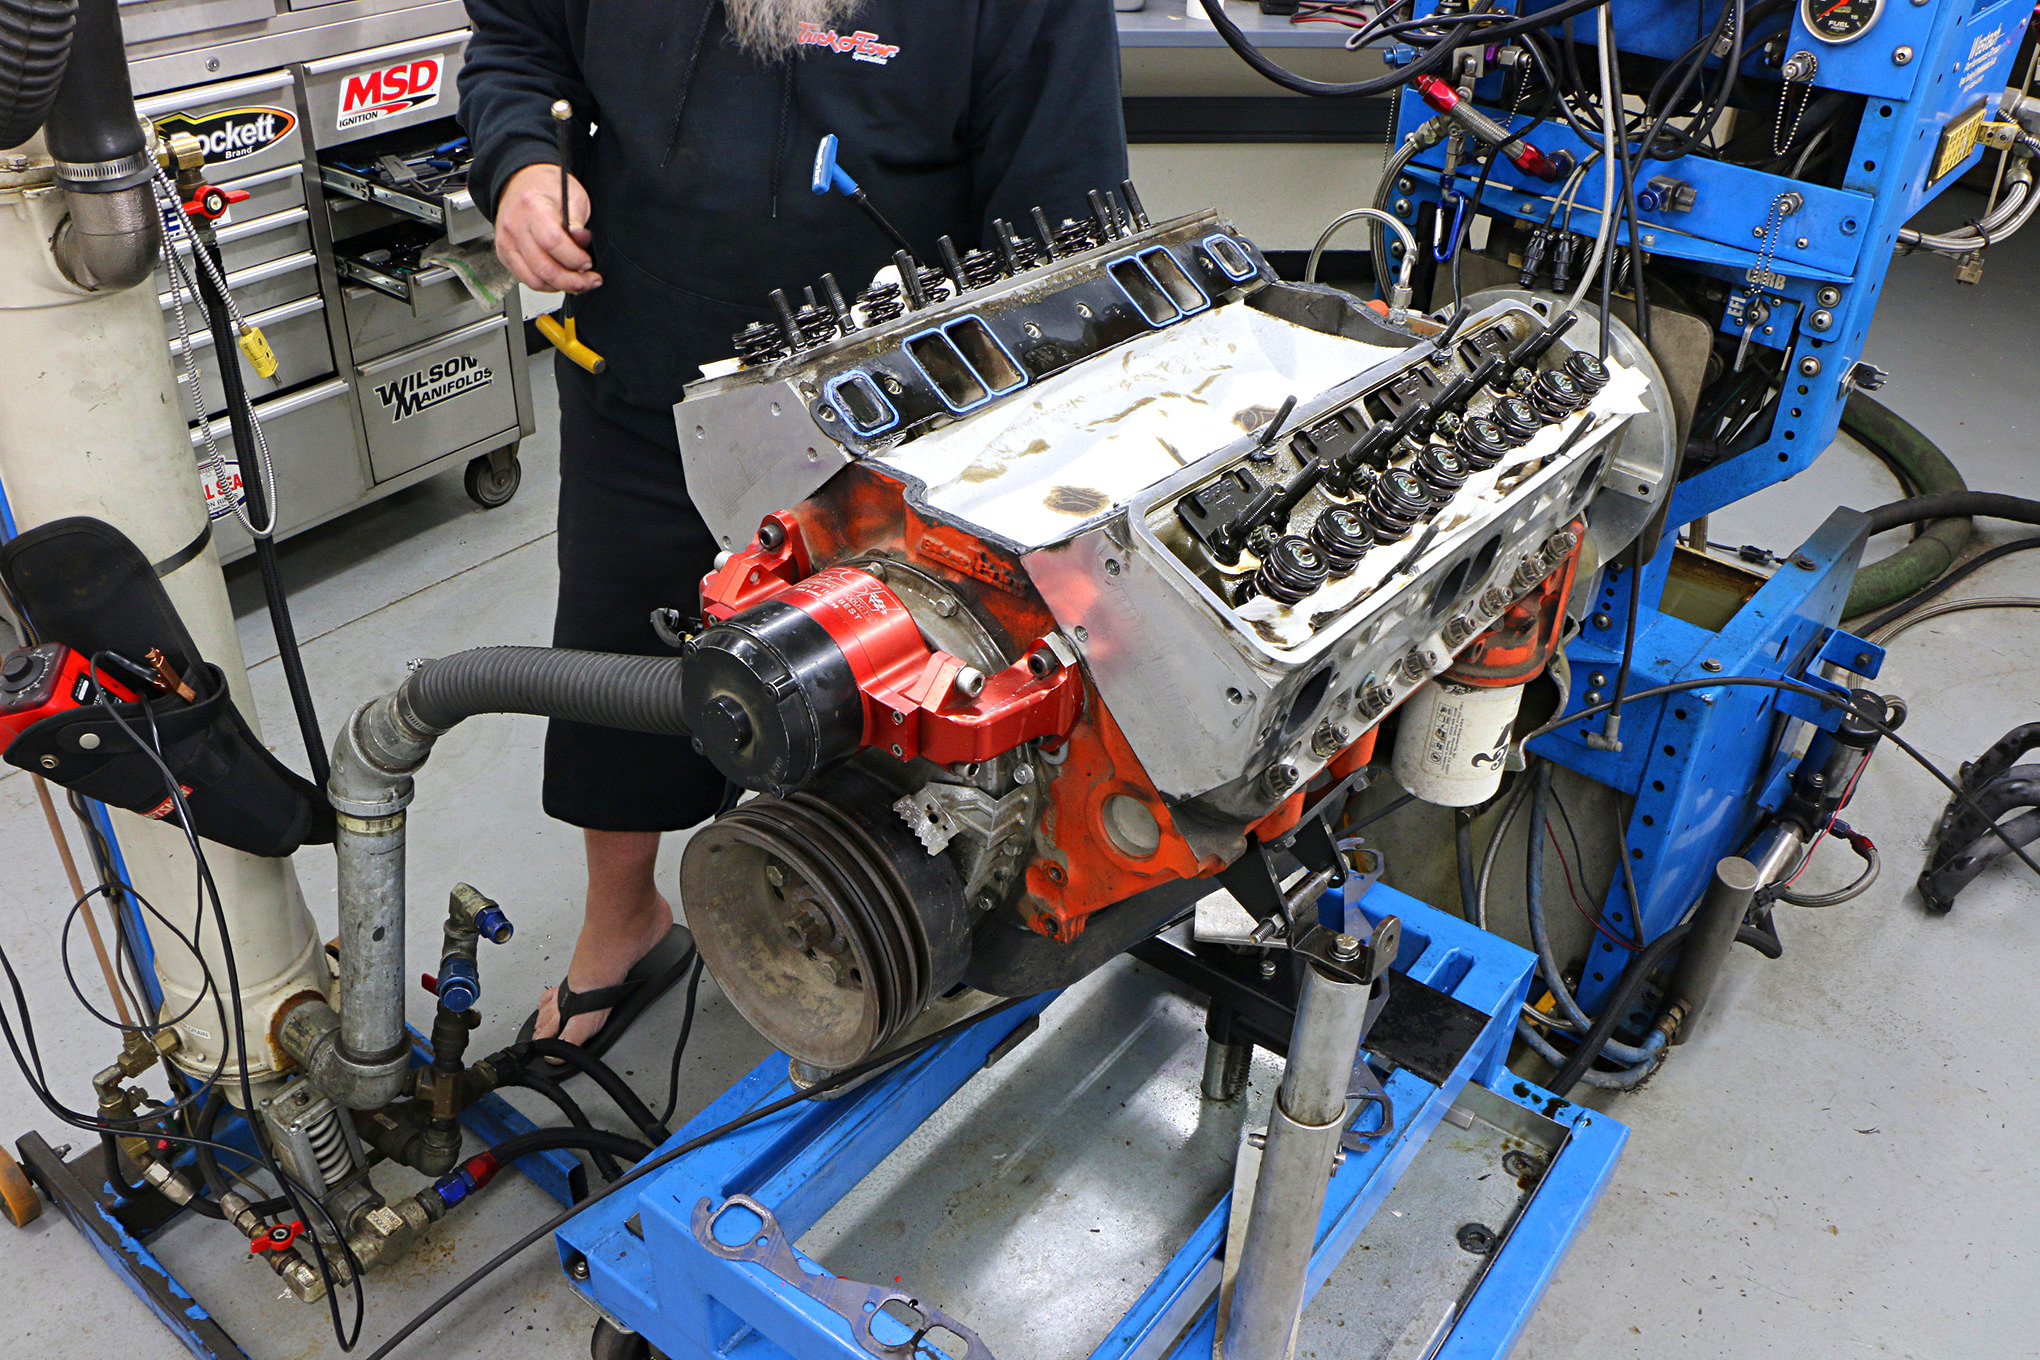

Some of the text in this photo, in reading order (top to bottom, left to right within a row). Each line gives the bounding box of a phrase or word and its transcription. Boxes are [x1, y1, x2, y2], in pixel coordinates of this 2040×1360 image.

[1828, 20, 1850, 28] FUEL
[342, 59, 439, 113] MSD
[339, 110, 379, 128] IGNITION
[225, 145, 253, 160] Brand
[1745, 268, 1786, 290] CARB
[1726, 295, 1747, 317] EFI
[374, 355, 478, 407] WILSON
[393, 367, 493, 421] MANIFOLDS
[216, 473, 244, 496] SEA
[838, 598, 863, 620] BEST
